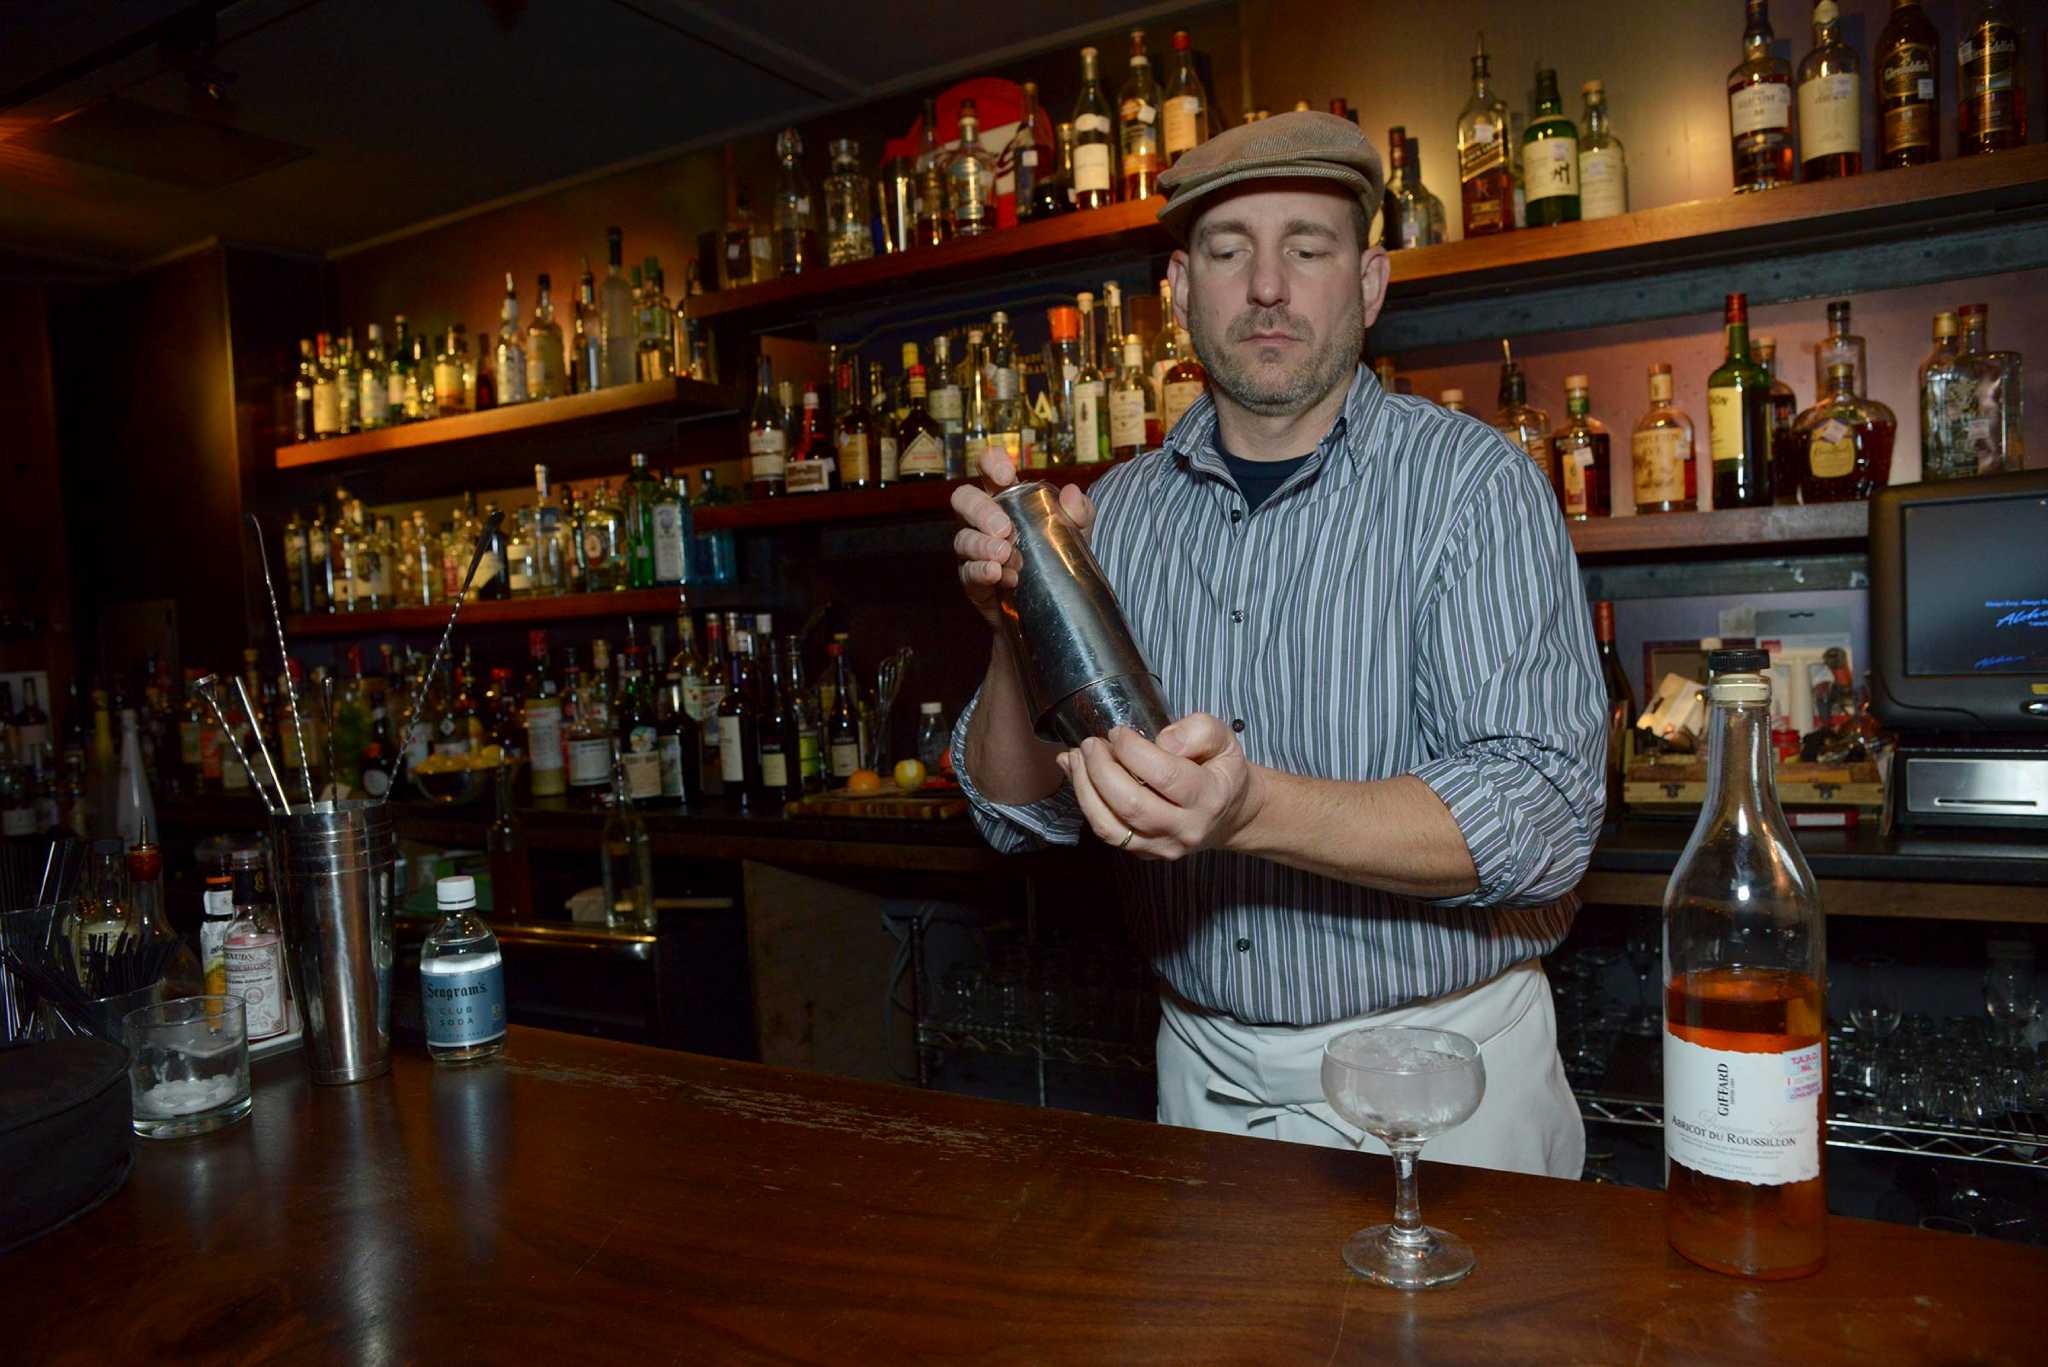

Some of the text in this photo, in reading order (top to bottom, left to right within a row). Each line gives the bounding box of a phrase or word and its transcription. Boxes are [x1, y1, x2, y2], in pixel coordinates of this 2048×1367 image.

[425, 981, 488, 1001] Seagram's
[440, 1017, 475, 1026] SODA
[1717, 1063, 1729, 1117] GIFFARD
